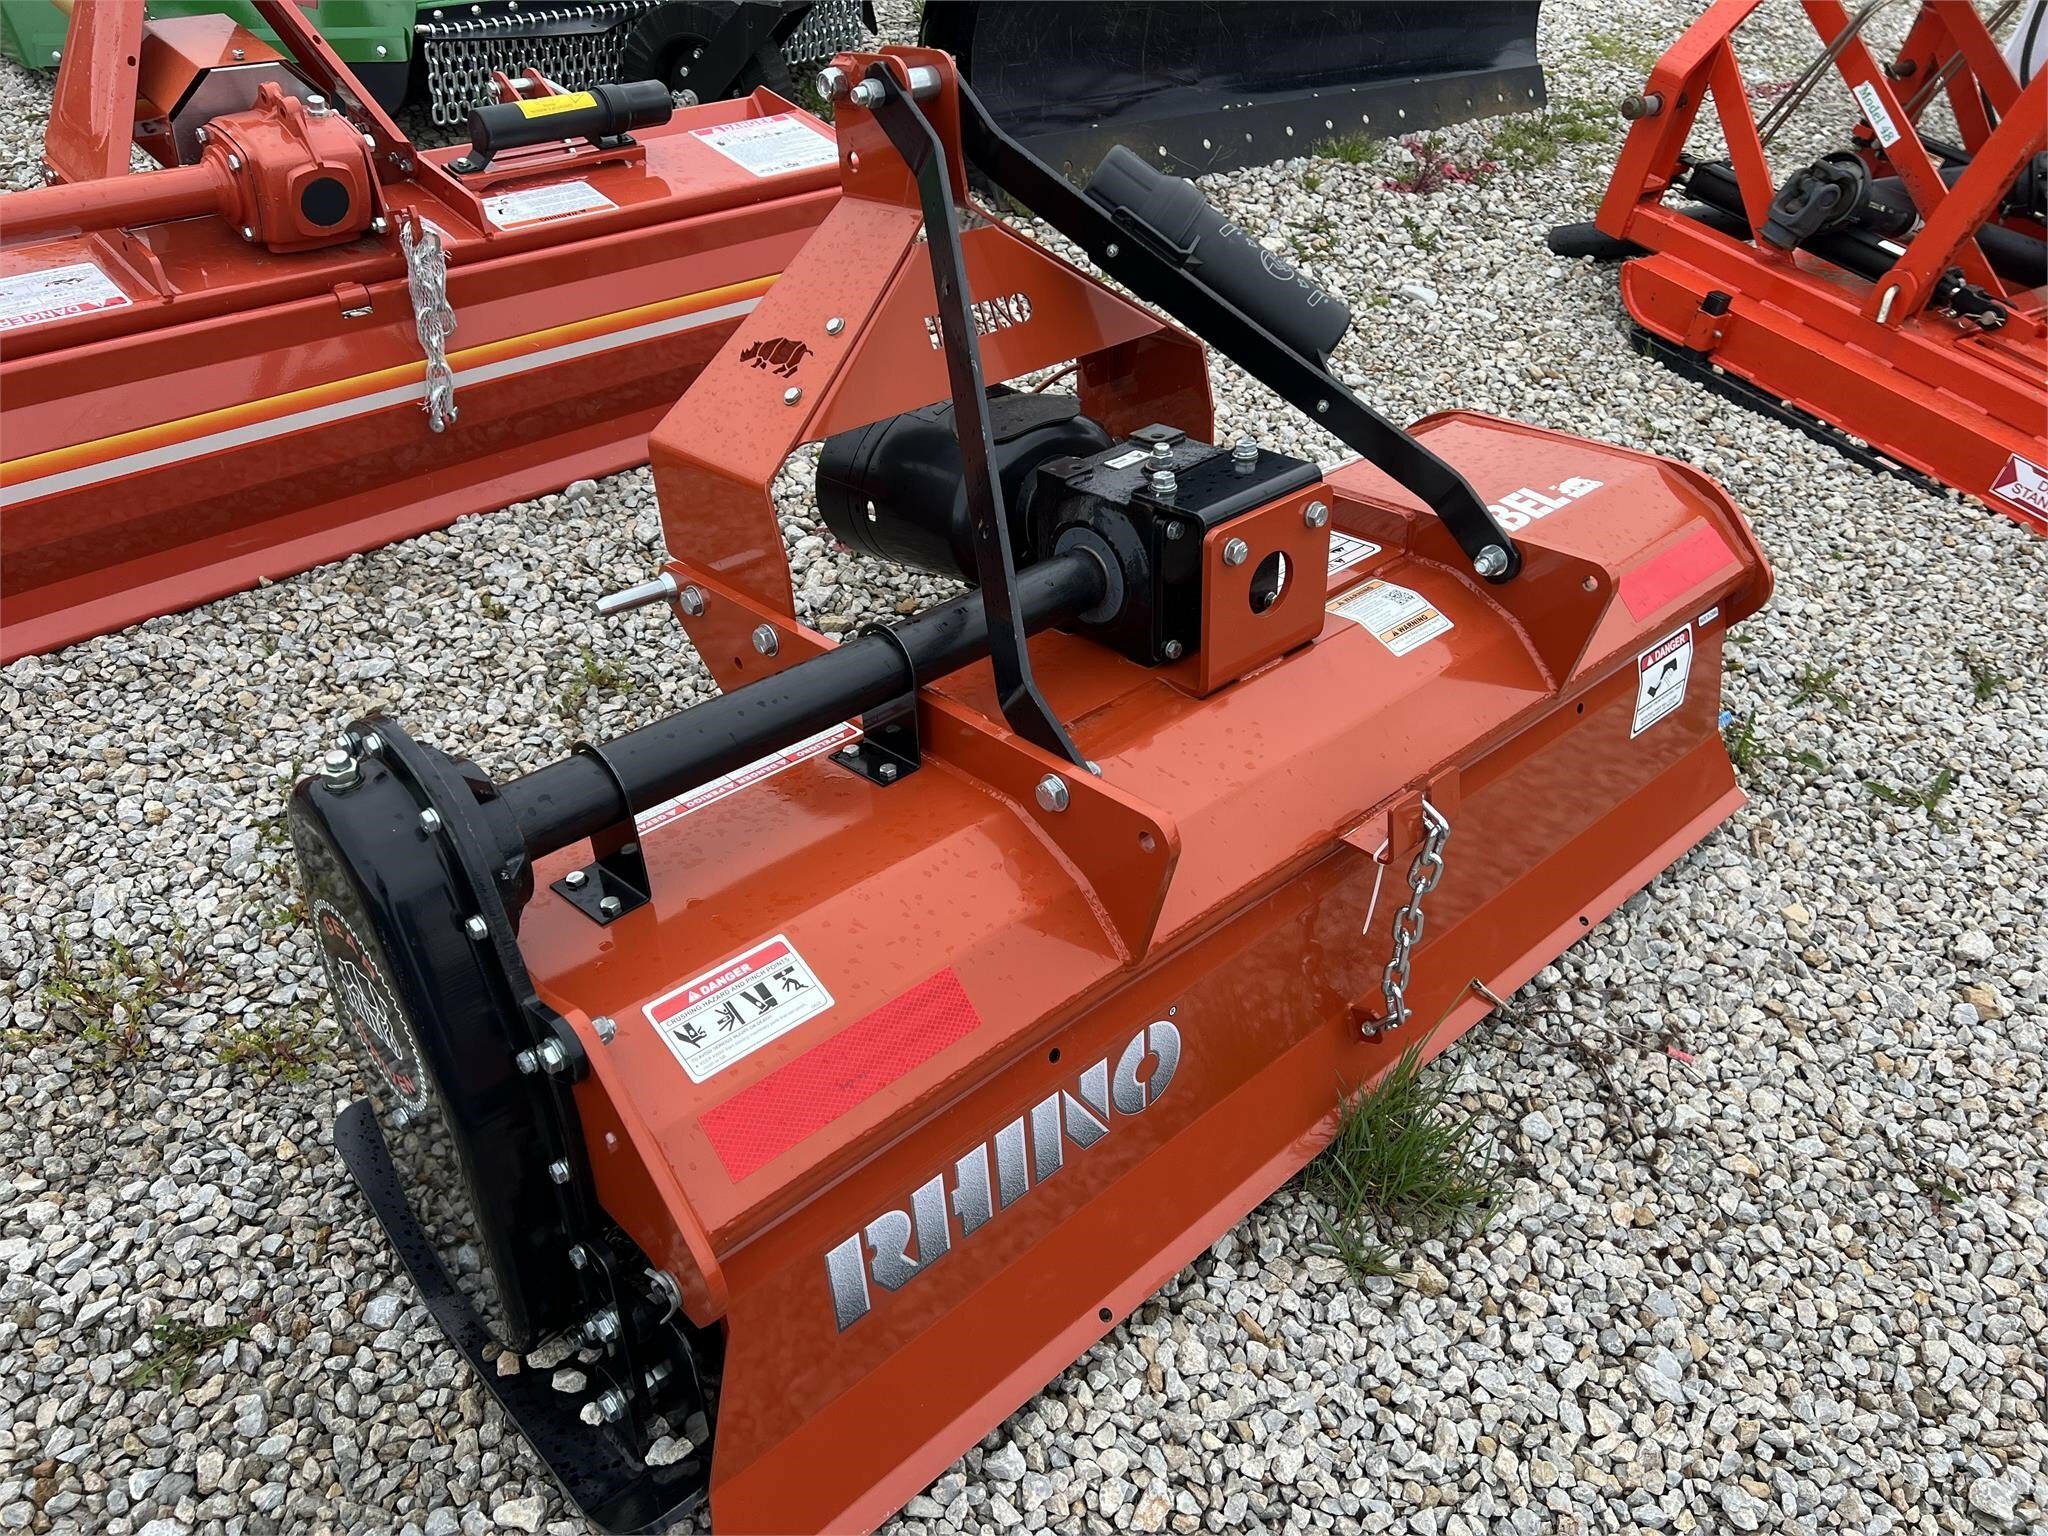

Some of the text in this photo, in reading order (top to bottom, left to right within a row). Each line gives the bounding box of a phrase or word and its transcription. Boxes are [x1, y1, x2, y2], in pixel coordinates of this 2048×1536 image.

[1858, 86, 1894, 142] Model 48
[1486, 487, 1573, 532] BEL
[1398, 614, 1428, 634] WARNING
[1655, 633, 1685, 660] DANGER
[794, 736, 838, 757] PELIGRO
[734, 762, 778, 784] DANGER
[685, 786, 726, 807] PERIGO
[323, 914, 378, 981] GEAR
[665, 956, 789, 1027] CRUSHING HAZARD AND PINCH POINTS
[698, 962, 752, 995] DANGER
[354, 1016, 416, 1095] DRIVEN
[825, 1020, 1182, 1334] RHINO
